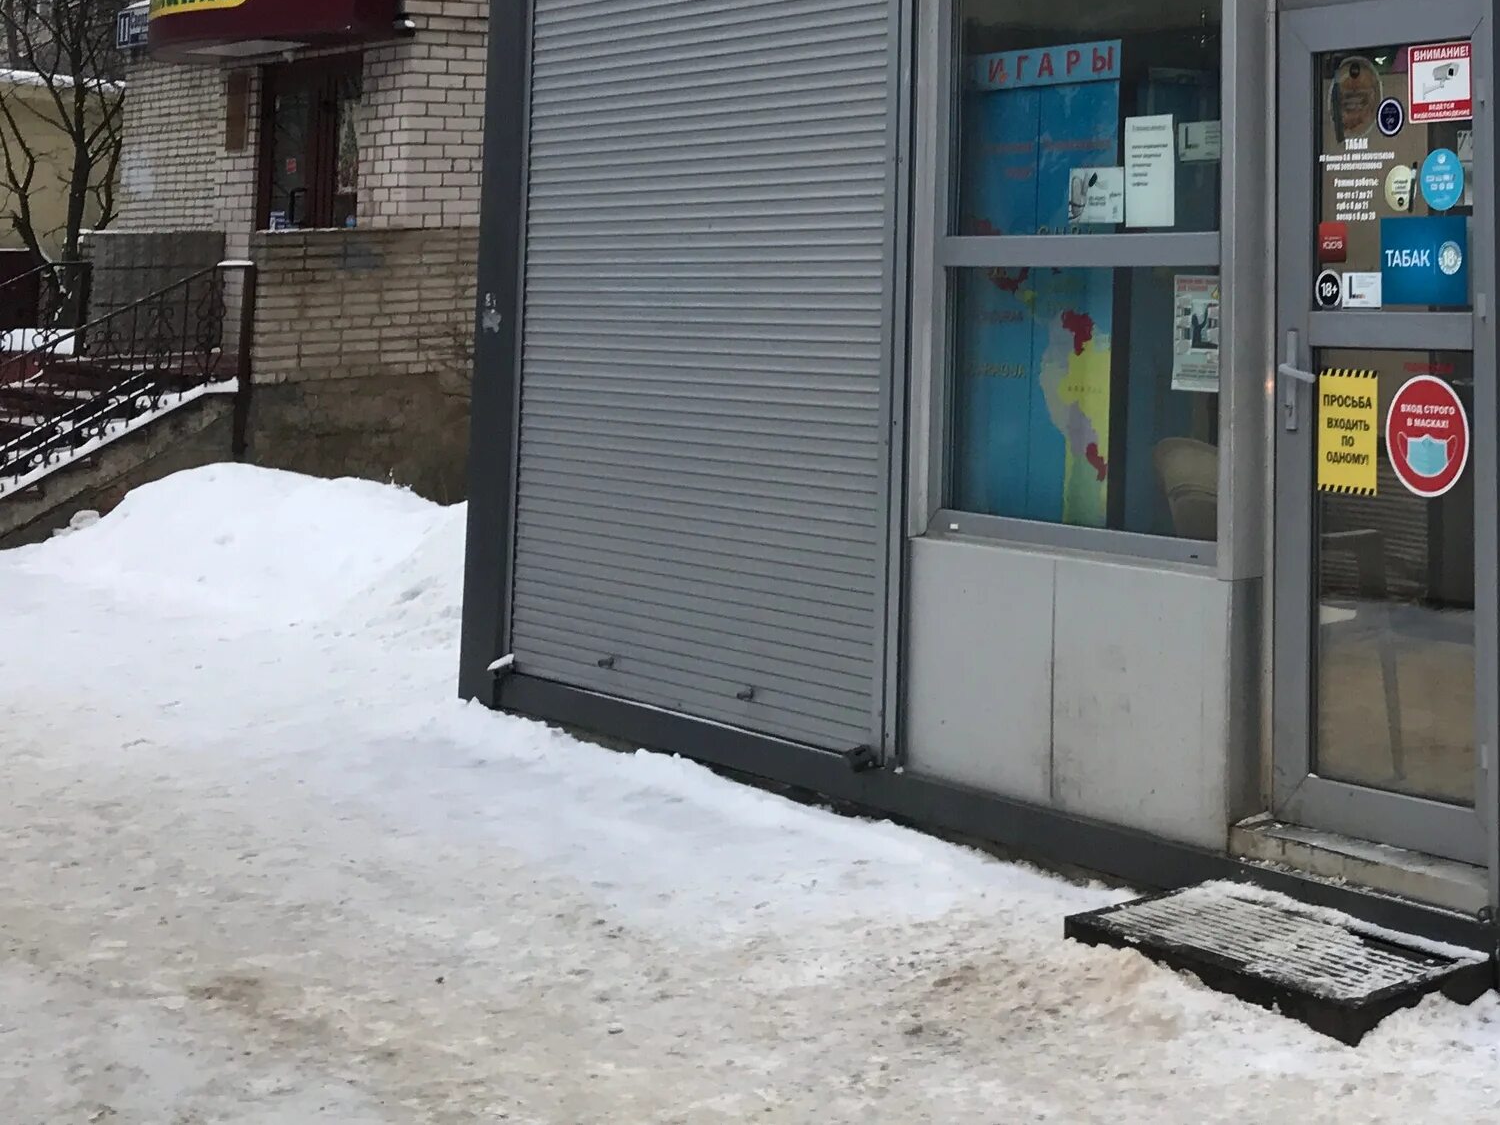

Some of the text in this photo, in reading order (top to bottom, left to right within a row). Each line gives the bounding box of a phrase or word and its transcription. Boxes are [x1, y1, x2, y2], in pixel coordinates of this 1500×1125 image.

[1413, 45, 1469, 62] ВНИМАНИЕ!
[1345, 137, 1369, 151] ТАБАК
[1385, 248, 1431, 268] ТАБАК
[1320, 281, 1338, 297] 18+
[1323, 393, 1372, 410] ПРОСЬБА
[1400, 403, 1456, 416] ВХОД СТРОГО
[1326, 417, 1370, 432] ВХОДИТЬ
[1406, 417, 1449, 429] В МАСКАХ!
[1341, 435, 1355, 448] ПО
[1326, 450, 1370, 466] ОДНОМУ!
